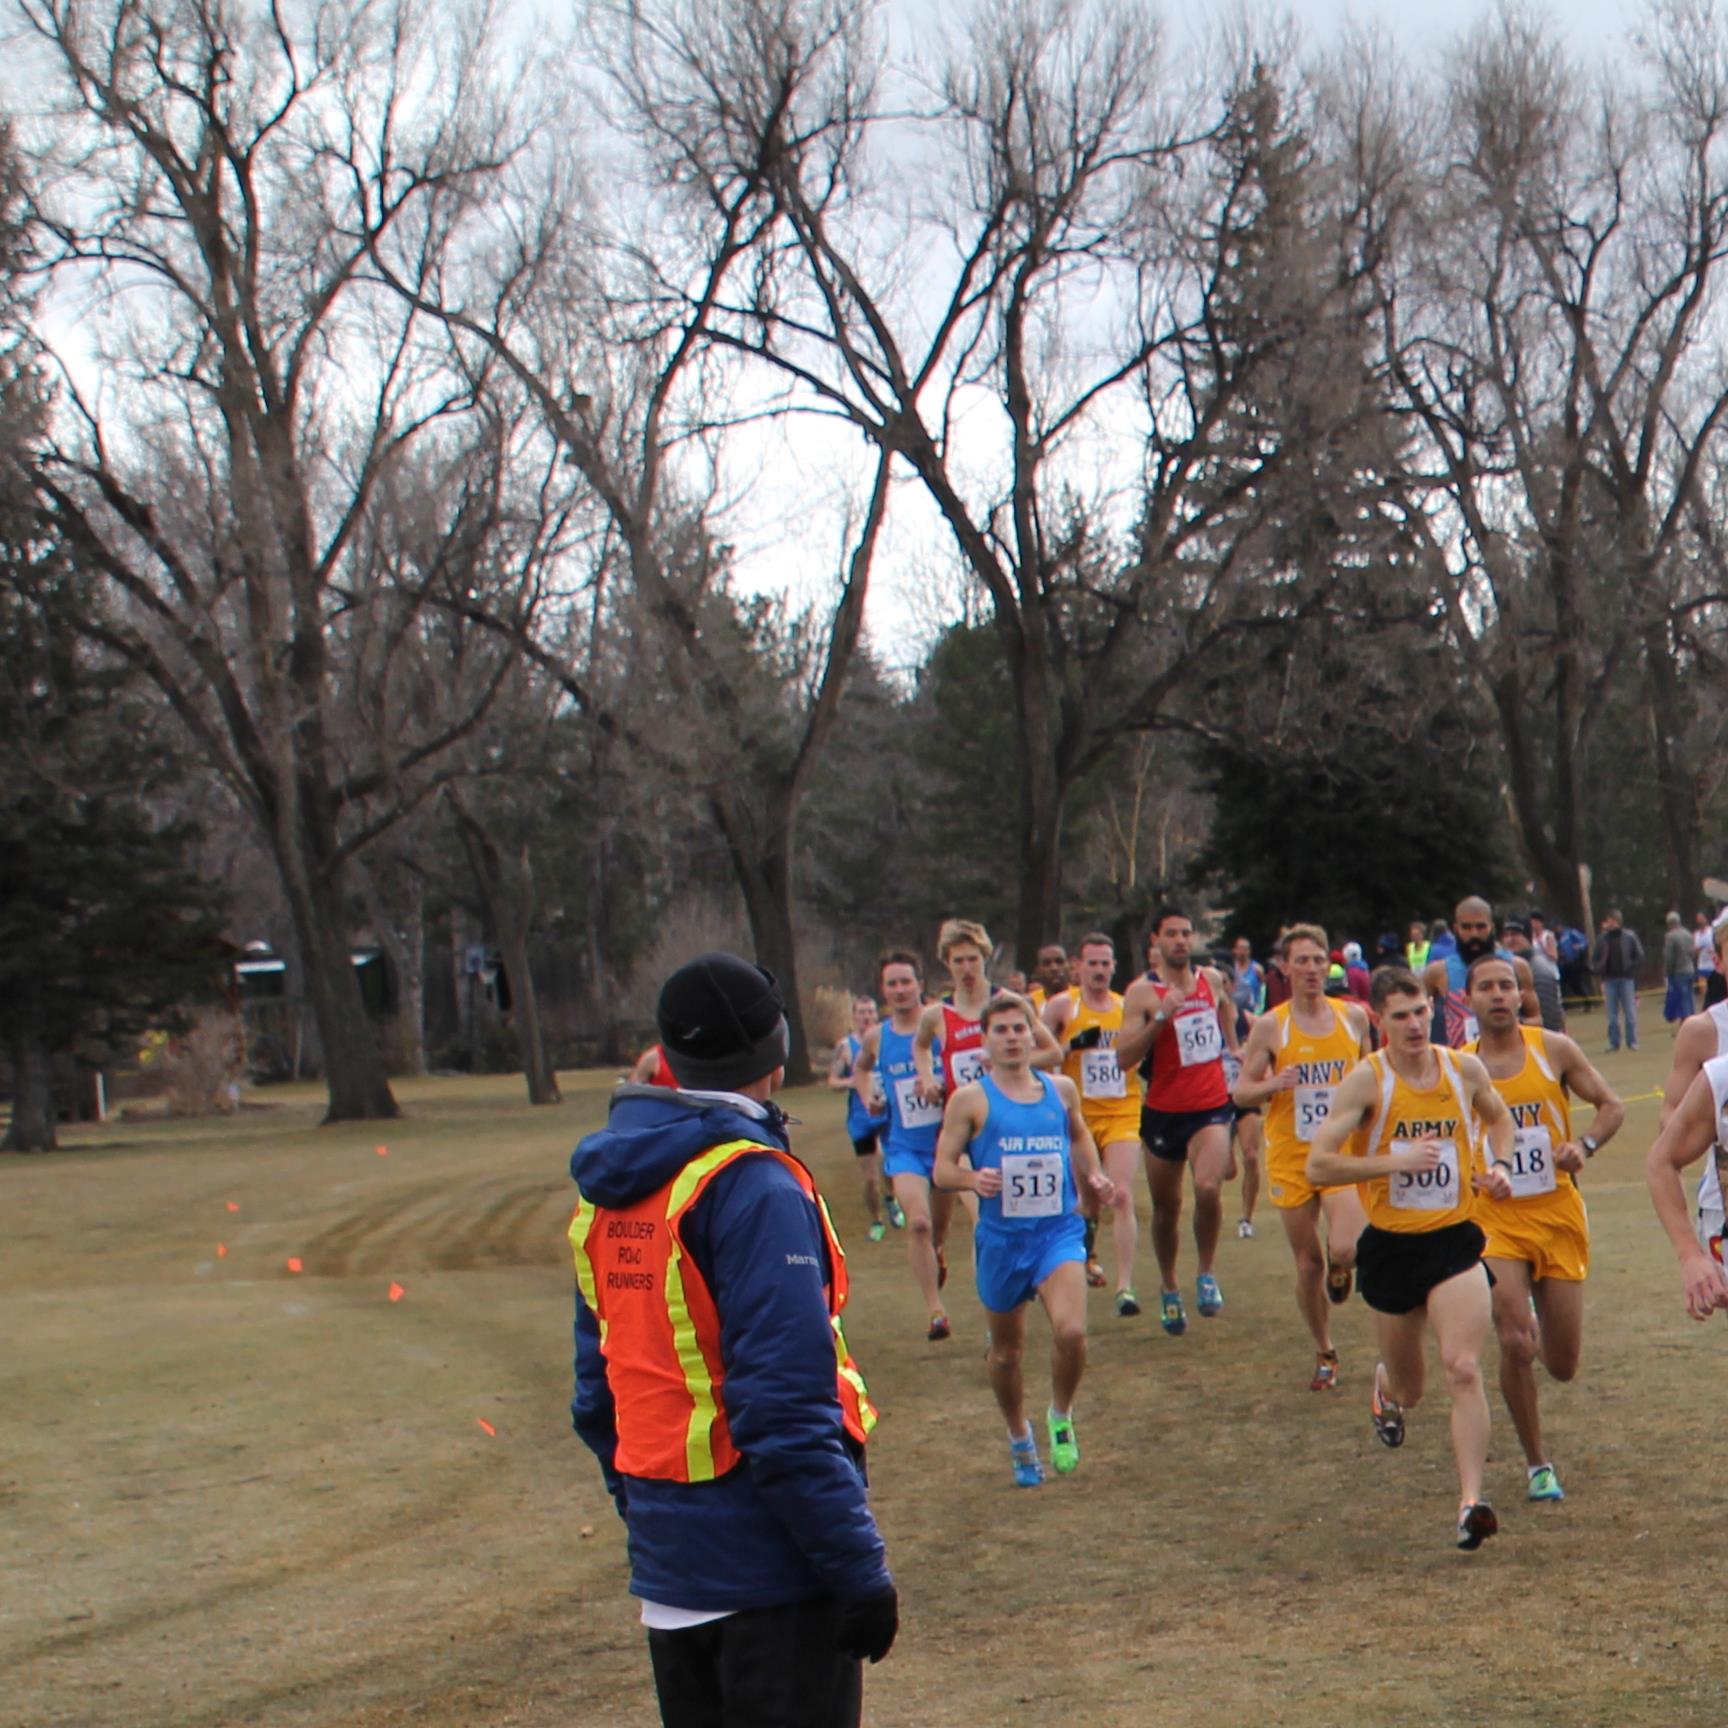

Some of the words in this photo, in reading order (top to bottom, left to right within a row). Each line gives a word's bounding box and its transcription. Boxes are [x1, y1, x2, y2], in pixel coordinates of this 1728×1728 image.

[1184, 1027, 1215, 1051] 567
[1087, 1064, 1121, 1084] 580
[1394, 1120, 1456, 1137] ARMY
[998, 1136, 1023, 1152] AIR
[1512, 1148, 1545, 1175] 18
[1012, 1173, 1056, 1198] 513
[607, 1221, 655, 1239] BOULDER
[606, 1272, 654, 1291] RUNNERS
